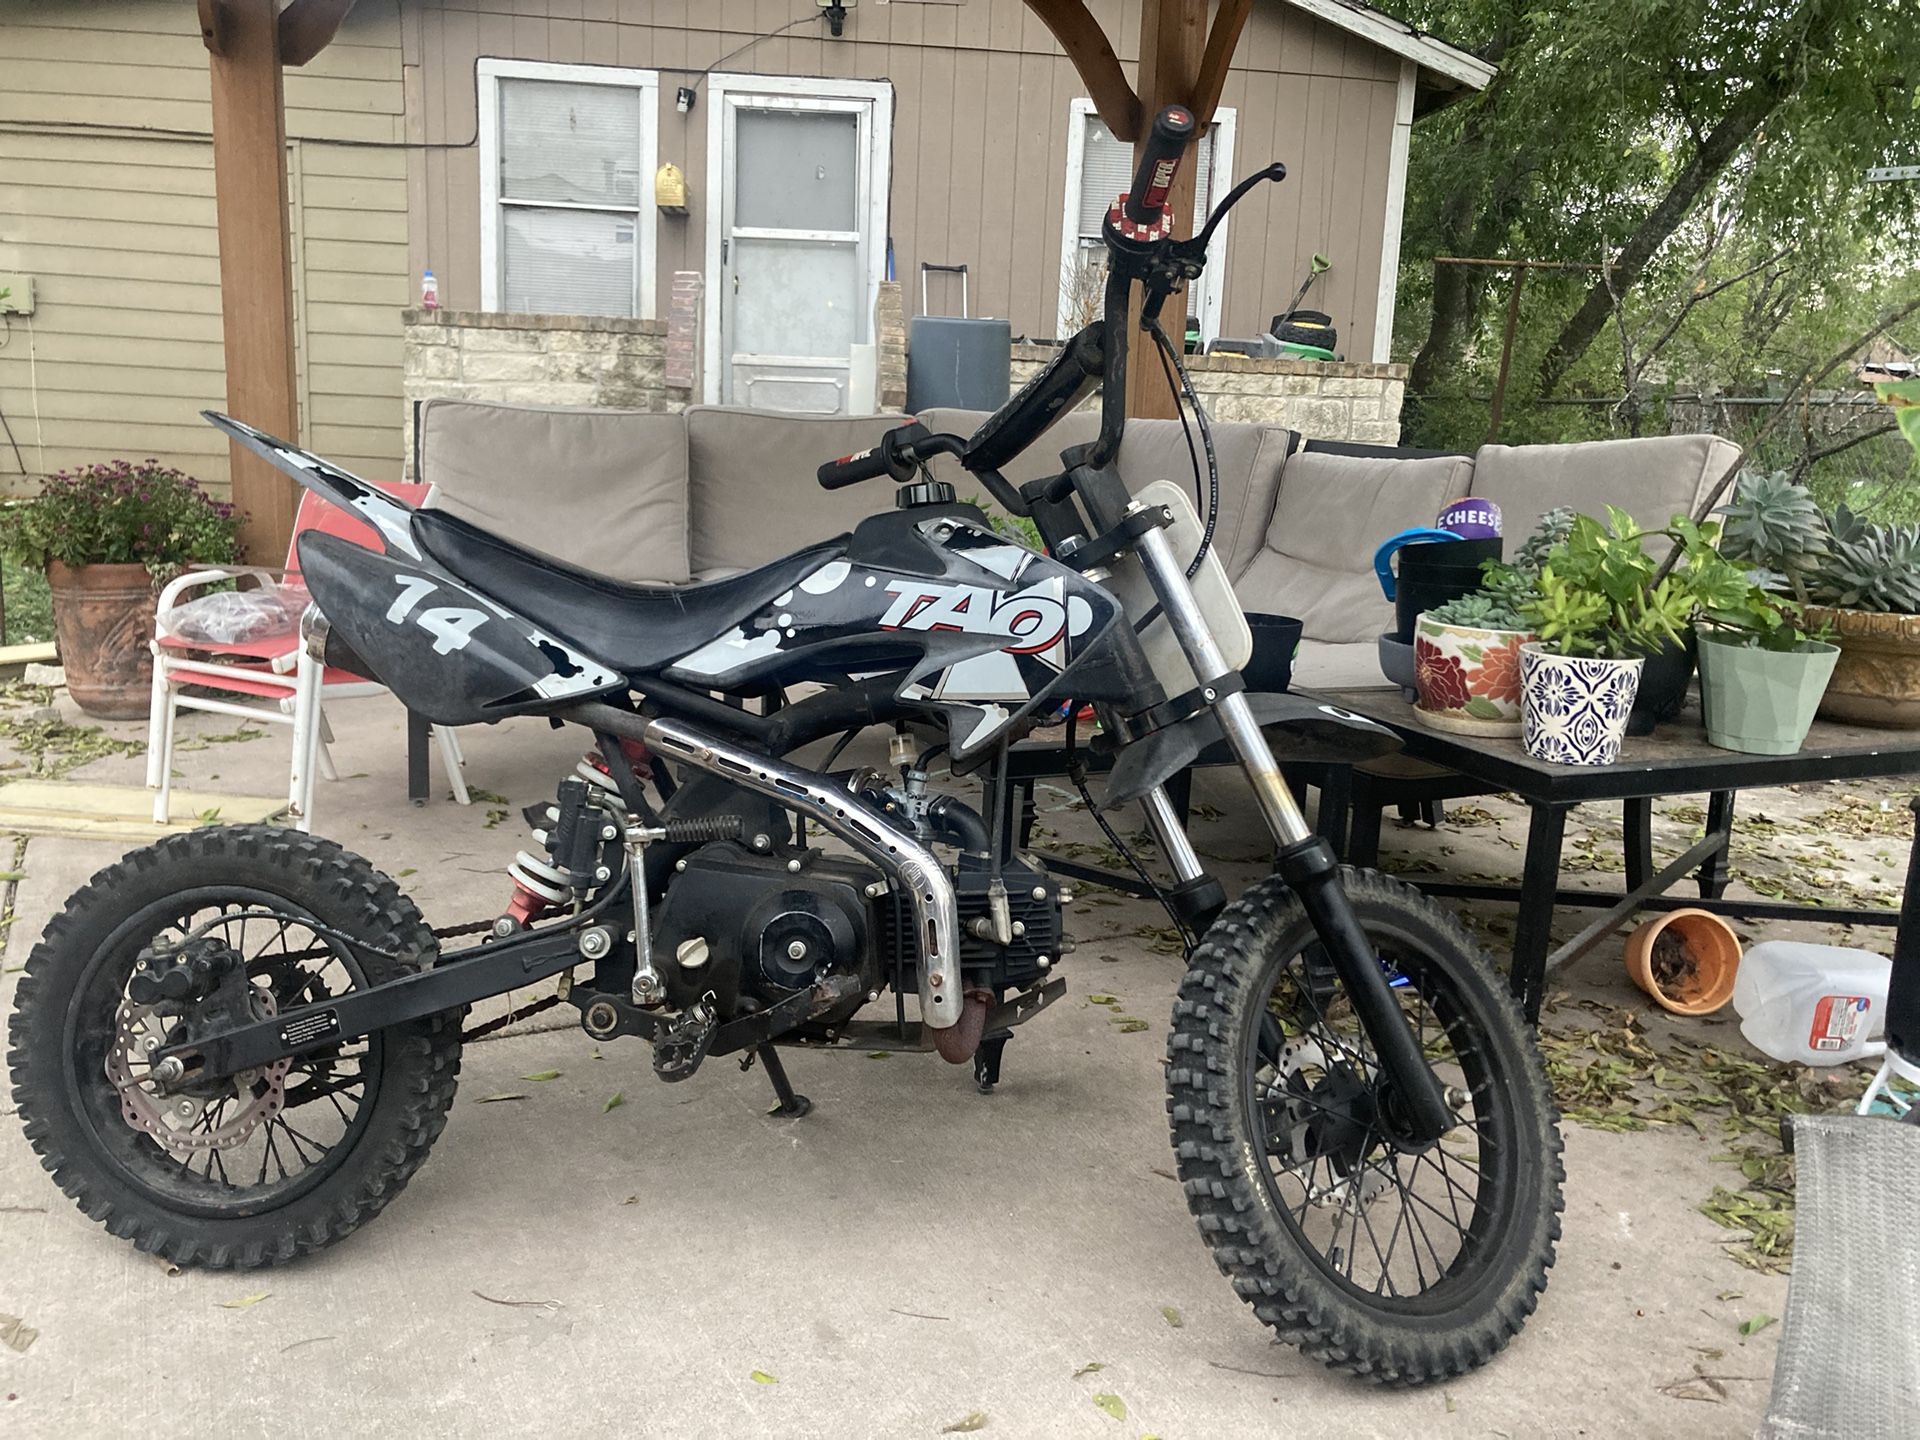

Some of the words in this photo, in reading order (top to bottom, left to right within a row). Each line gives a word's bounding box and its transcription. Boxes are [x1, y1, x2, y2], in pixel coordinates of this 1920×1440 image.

[1446, 510, 1502, 532] CHEESE
[386, 574, 490, 656] 14
[877, 580, 1068, 655] TAO
